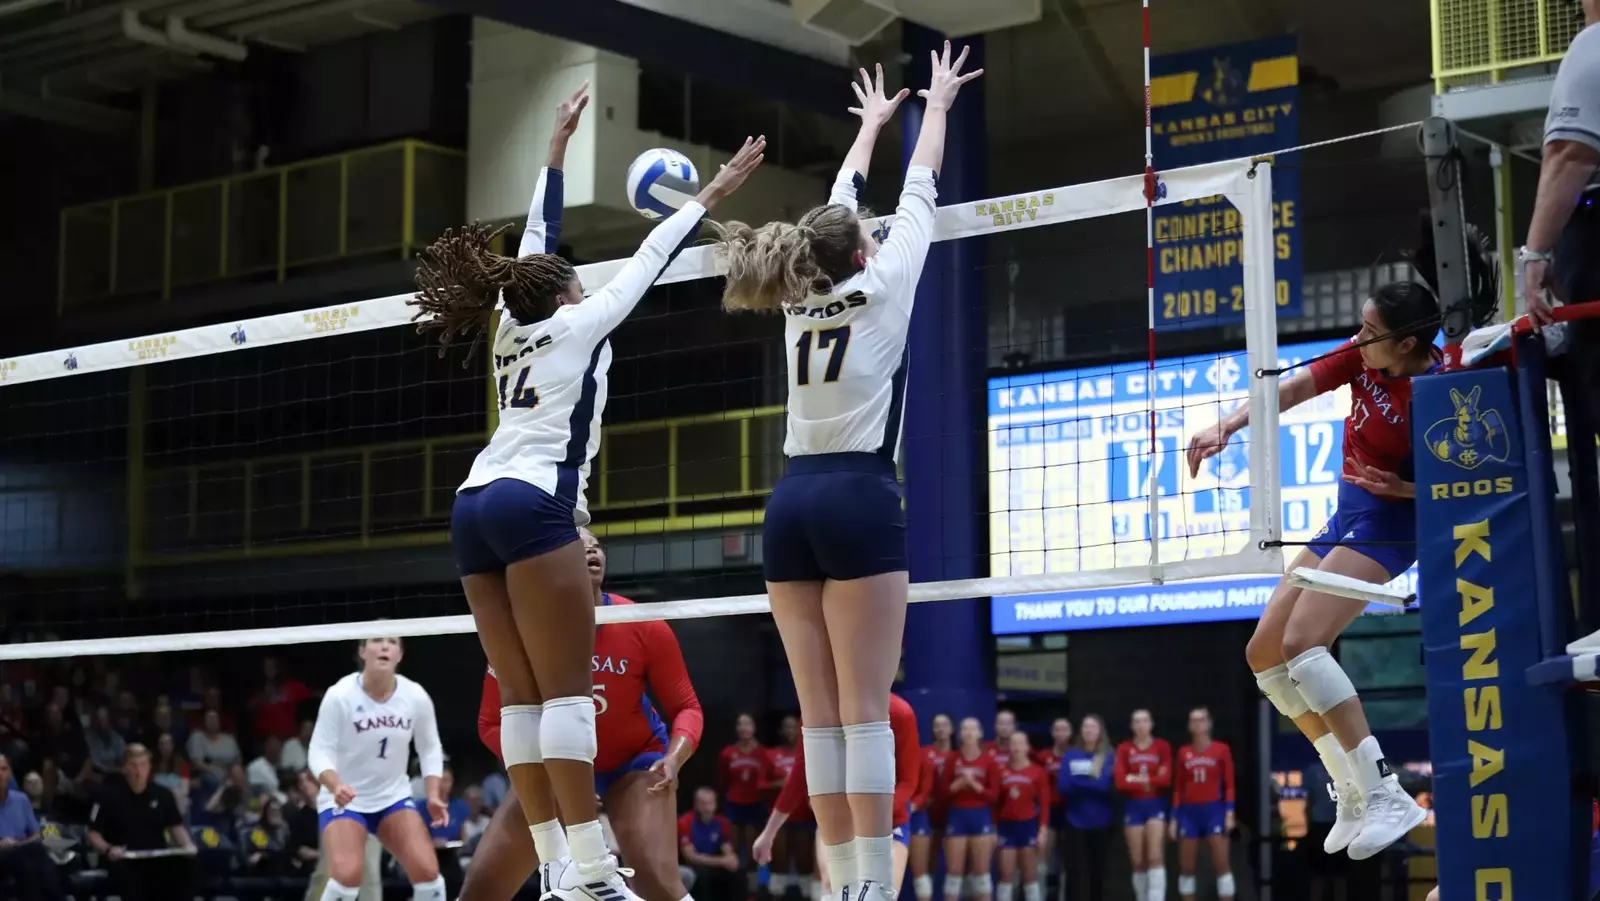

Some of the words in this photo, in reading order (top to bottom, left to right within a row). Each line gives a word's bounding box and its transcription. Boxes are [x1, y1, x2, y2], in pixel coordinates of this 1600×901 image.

[1153, 111, 1236, 135] KANSAS
[1243, 104, 1292, 122] CITY
[975, 193, 1055, 217] KANSAS
[992, 208, 1038, 227] CITY
[1155, 201, 1295, 243] CONFERCE
[1160, 233, 1290, 274] CHAMPIS
[303, 306, 359, 324] KANSAS
[315, 317, 347, 333] CITY
[796, 325, 851, 386] 17
[499, 365, 540, 411] 14
[998, 378, 1115, 408] KANSAS
[1126, 368, 1197, 395] CITY
[1101, 410, 1185, 435] ROOS
[1289, 423, 1335, 485] 12
[1431, 477, 1514, 500] ROOS
[1014, 601, 1063, 621] THANK
[1065, 599, 1095, 618] YOU
[1096, 597, 1116, 616] TO
[1117, 595, 1149, 614] OUR
[1149, 589, 1225, 612] FOUNDING
[1453, 518, 1510, 839] KANSAS
[353, 715, 412, 733] KANSAS
[377, 737, 388, 760] 1
